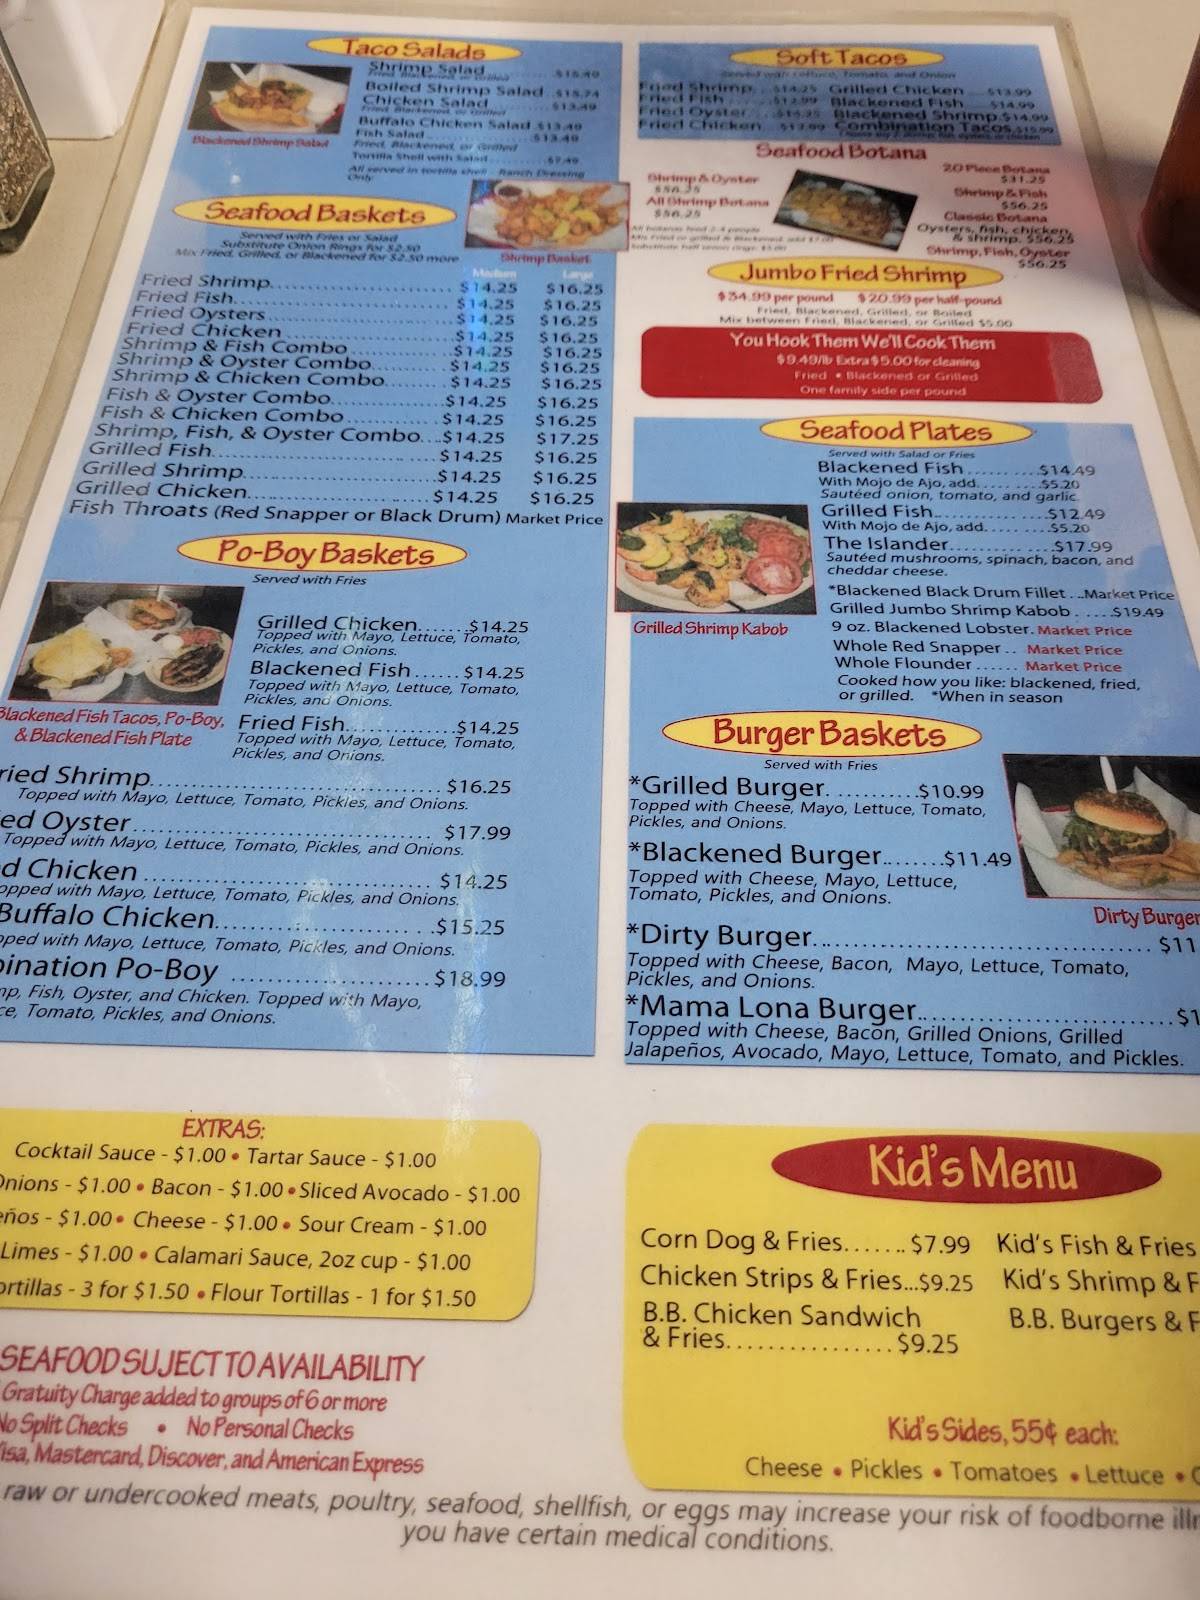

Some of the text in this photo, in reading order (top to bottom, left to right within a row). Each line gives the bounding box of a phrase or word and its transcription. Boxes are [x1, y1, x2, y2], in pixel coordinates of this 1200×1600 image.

[343, 38, 487, 60] Taco Salads
[777, 48, 908, 66] Soft Tacos
[366, 81, 543, 97] Boiled Shrimp Salad
[830, 85, 963, 97] Grilled Chicken
[359, 116, 530, 131] Buffalo Chicken Salad
[756, 143, 926, 161] Seafood Botana
[205, 202, 425, 224] Seafood Baskets
[240, 232, 283, 242] Served
[286, 233, 313, 242] with
[317, 233, 344, 242] Fries
[740, 264, 966, 287] Jumbo Fried Shrimp
[718, 292, 833, 306] $34.99 per pound
[858, 293, 1002, 307] $20.99 per half-pound
[730, 333, 995, 350] You Hook Them We'll Cook Them
[777, 354, 980, 369] $9.49/lb Extra $5.00 for cleaning
[112, 368, 601, 390] Shrimp & Chicken Combo $14.25 $16.25
[800, 386, 826, 394] One
[830, 386, 868, 396] family
[900, 389, 920, 397] per
[925, 388, 966, 397] pound
[801, 420, 992, 441] Seafood Plates
[818, 461, 921, 473] Blackened
[1040, 465, 1095, 476] $14.49
[821, 488, 882, 499] Sautéed
[887, 492, 935, 501] onion,
[940, 491, 997, 501] tomato,
[1003, 492, 1030, 501] and
[69, 500, 603, 525] Fish Throats (Red Snapper or Black Drum) Market Price
[824, 537, 862, 549] The
[217, 540, 434, 567] Po-Boy Baskets
[634, 621, 788, 640] Grilled Shrimp Kabob
[834, 640, 1122, 655] Whole Red Snapper Market Price
[251, 661, 361, 676] Blackened
[464, 666, 524, 679] $14.25
[15, 728, 192, 746] & Blackened Fish Plate
[714, 718, 946, 752] Burger Baskets
[19, 788, 468, 811] Topped with Mayo, Lettuce, Tomato, Pickles, and Onions.
[1094, 907, 1200, 930] Dirty Burger
[182, 1119, 265, 1139] EXTRAS:
[16, 1142, 92, 1159] Cocktail
[99, 1144, 155, 1161] Sauce
[174, 1146, 225, 1163] $1.00
[869, 1144, 1077, 1189] Kid's Menu
[641, 1228, 697, 1248] Corn
[707, 1229, 754, 1255] Dog
[764, 1231, 779, 1250] &
[912, 1234, 970, 1255] $7.99
[998, 1233, 1196, 1256] Kid's Fish & Fries
[0, 1345, 425, 1382] SEAFOOD SUJECT TO AVAILABILITY
[187, 1416, 353, 1440] No Personal Checks
[889, 1416, 1118, 1446] Kid's Sides, 55¢ each:
[746, 1456, 1164, 1485] Cheese Pickles Tomatoes Lettuce
[400, 1520, 832, 1552] you have certain medical conditions.
